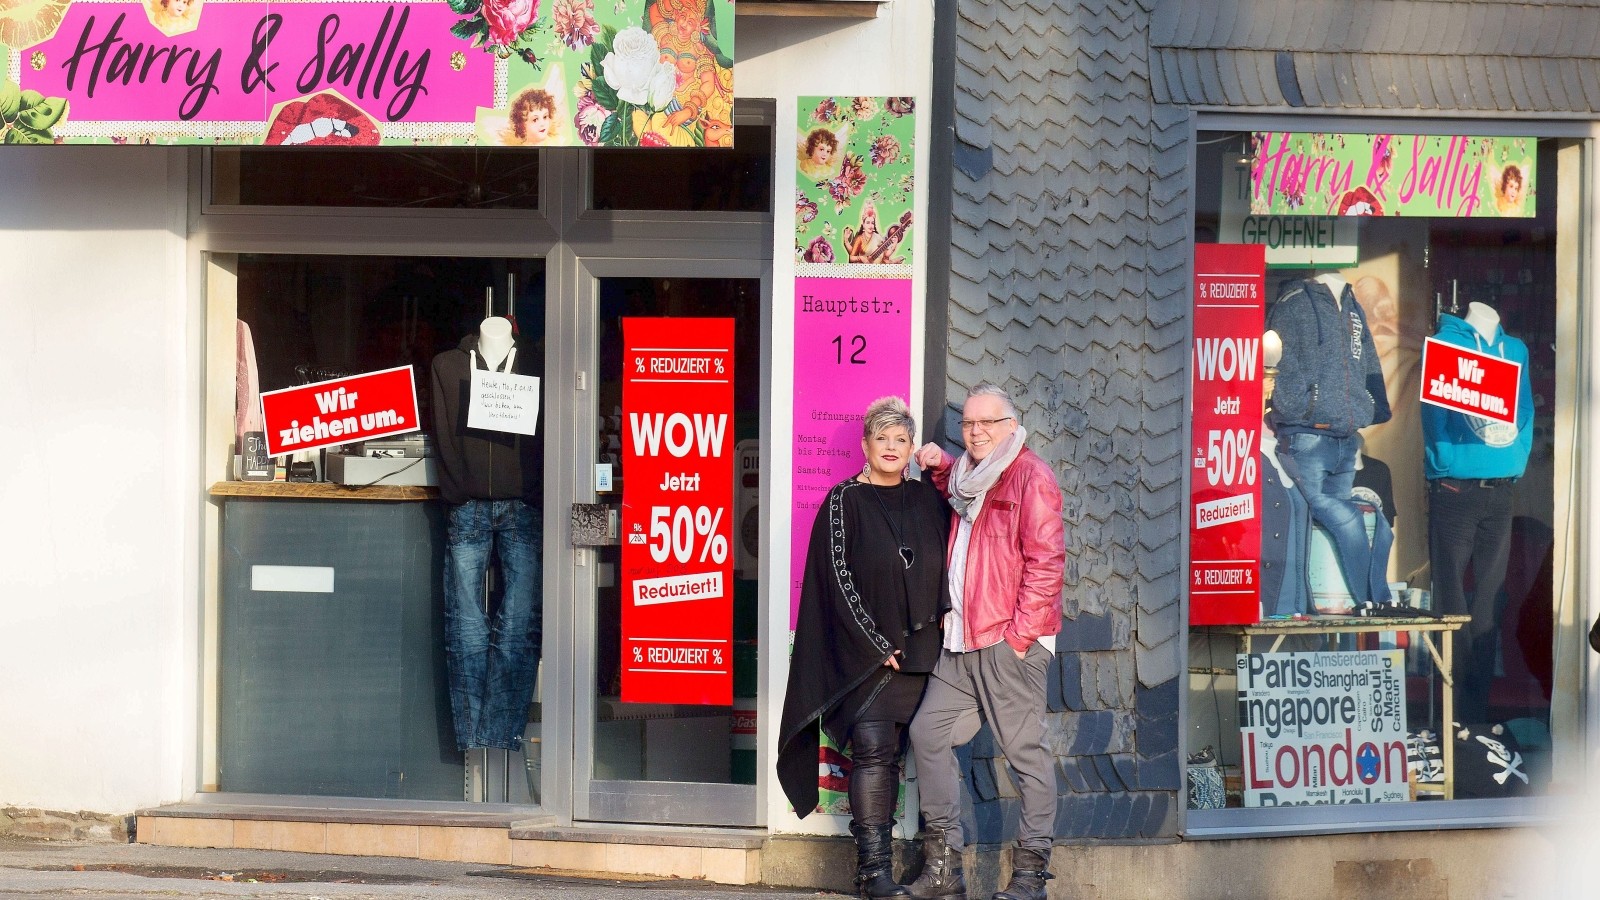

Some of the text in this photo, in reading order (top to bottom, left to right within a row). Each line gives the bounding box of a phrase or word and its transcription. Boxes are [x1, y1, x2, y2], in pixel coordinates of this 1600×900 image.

[62, 6, 430, 121] Harry & Sally
[1251, 132, 1482, 217] Harry & Sally
[1200, 283, 1257, 299] % REDUZIERT %
[803, 296, 900, 317] Hauptstr.
[832, 335, 866, 364] 12
[1197, 338, 1259, 381] WOW
[636, 358, 724, 373] % REDUZIERT %
[1458, 357, 1485, 384] Wir
[315, 387, 358, 414] Wir
[1214, 397, 1240, 415] Jetzt
[1430, 374, 1508, 416] ziehen um.
[280, 409, 405, 446] ziehen um.
[811, 410, 865, 422] Öffnungsze
[630, 413, 727, 457] WOW
[797, 435, 827, 445] Montag
[798, 447, 851, 458] bis Freitag
[660, 473, 700, 491] Jetzt
[797, 465, 831, 476] Samstag
[1200, 499, 1250, 523] Reduziert!
[1195, 569, 1252, 585] % REDUZIERT %
[639, 578, 717, 600] Reduziert!
[633, 647, 722, 664] % REDUZIERT %
[1313, 653, 1377, 667] Amsterdam
[1249, 653, 1312, 689] Paris
[1314, 669, 1369, 692] Shanghai
[1382, 657, 1394, 717] Madrid
[1369, 670, 1383, 733] Seoul
[1392, 679, 1401, 732] Cancun
[1248, 728, 1407, 789] London
[1383, 791, 1404, 801] Sydney
